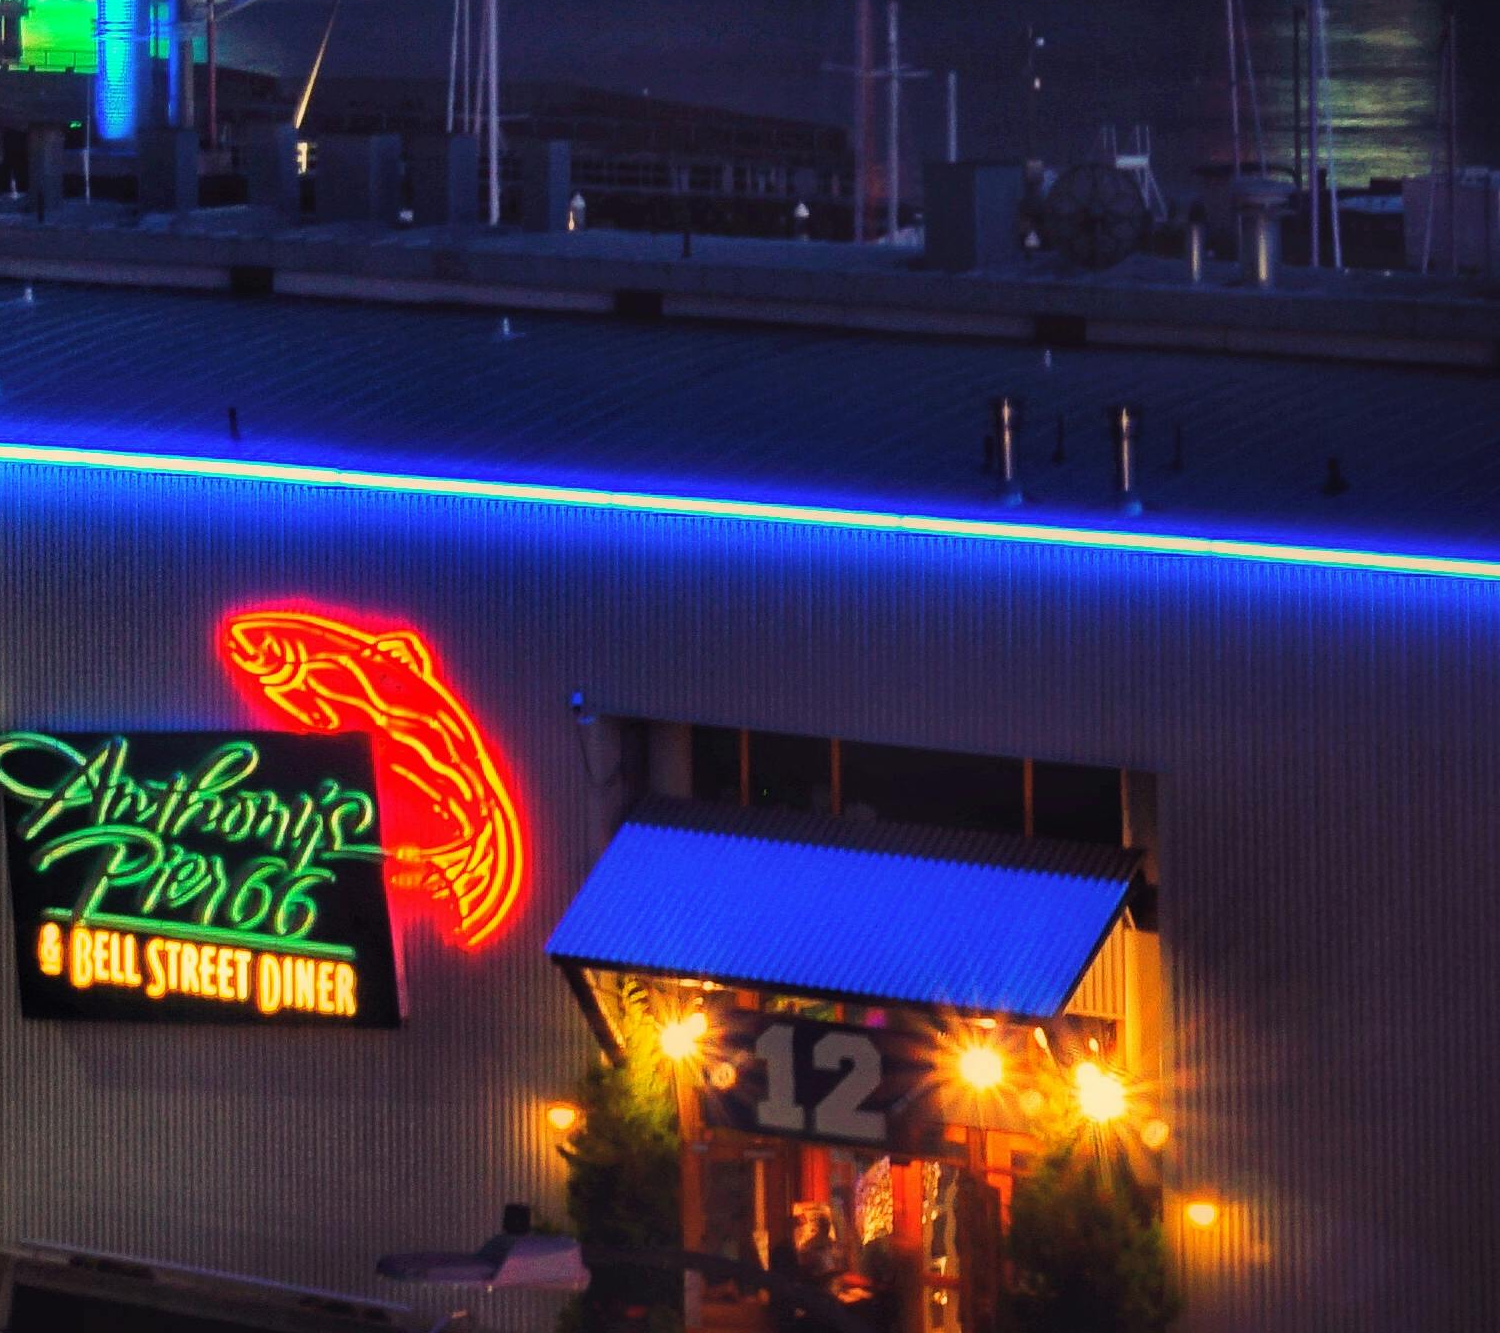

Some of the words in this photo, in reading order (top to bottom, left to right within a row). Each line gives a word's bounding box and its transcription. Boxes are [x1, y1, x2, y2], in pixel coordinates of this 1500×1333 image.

[36, 824, 229, 926] Pier
[229, 854, 337, 944] 66
[39, 921, 64, 976] &
[70, 926, 143, 988] BELL
[145, 936, 252, 1000] STREET
[257, 950, 358, 1017] DINER
[755, 1024, 887, 1140] 12
